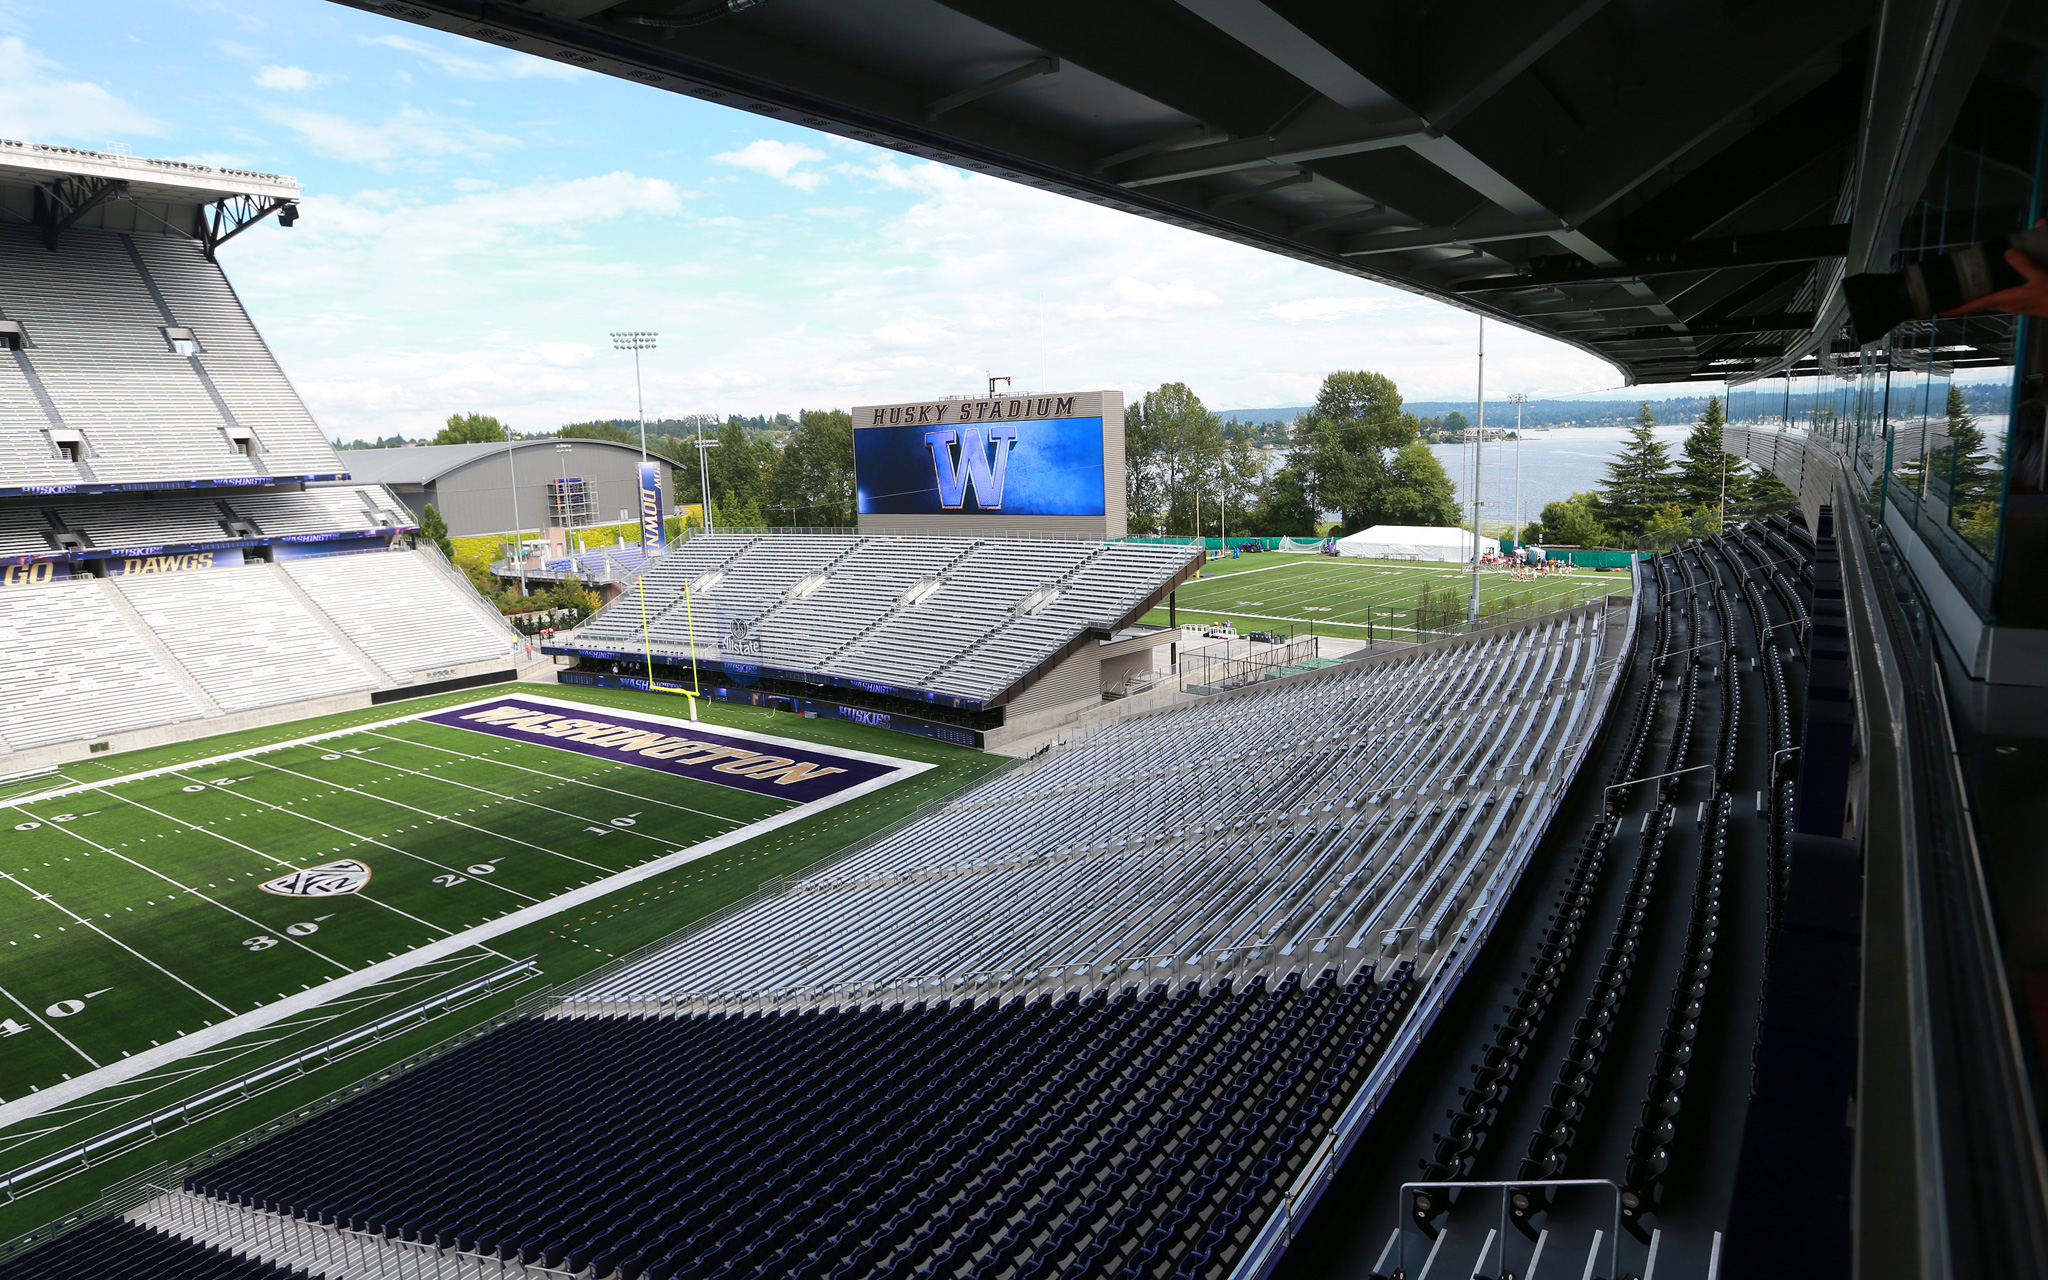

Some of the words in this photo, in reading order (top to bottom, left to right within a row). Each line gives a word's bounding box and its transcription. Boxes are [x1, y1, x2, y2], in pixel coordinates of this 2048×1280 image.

[873, 404, 948, 426] HUSKY
[960, 396, 1077, 421] STADIUM
[924, 425, 1018, 510] W
[4, 562, 54, 587] GO
[122, 552, 214, 577] DAWGS
[721, 635, 760, 655] Allstate
[620, 678, 683, 693] WASHNGT
[838, 706, 891, 729] HUSKIES
[459, 706, 849, 785] WASHINGTON
